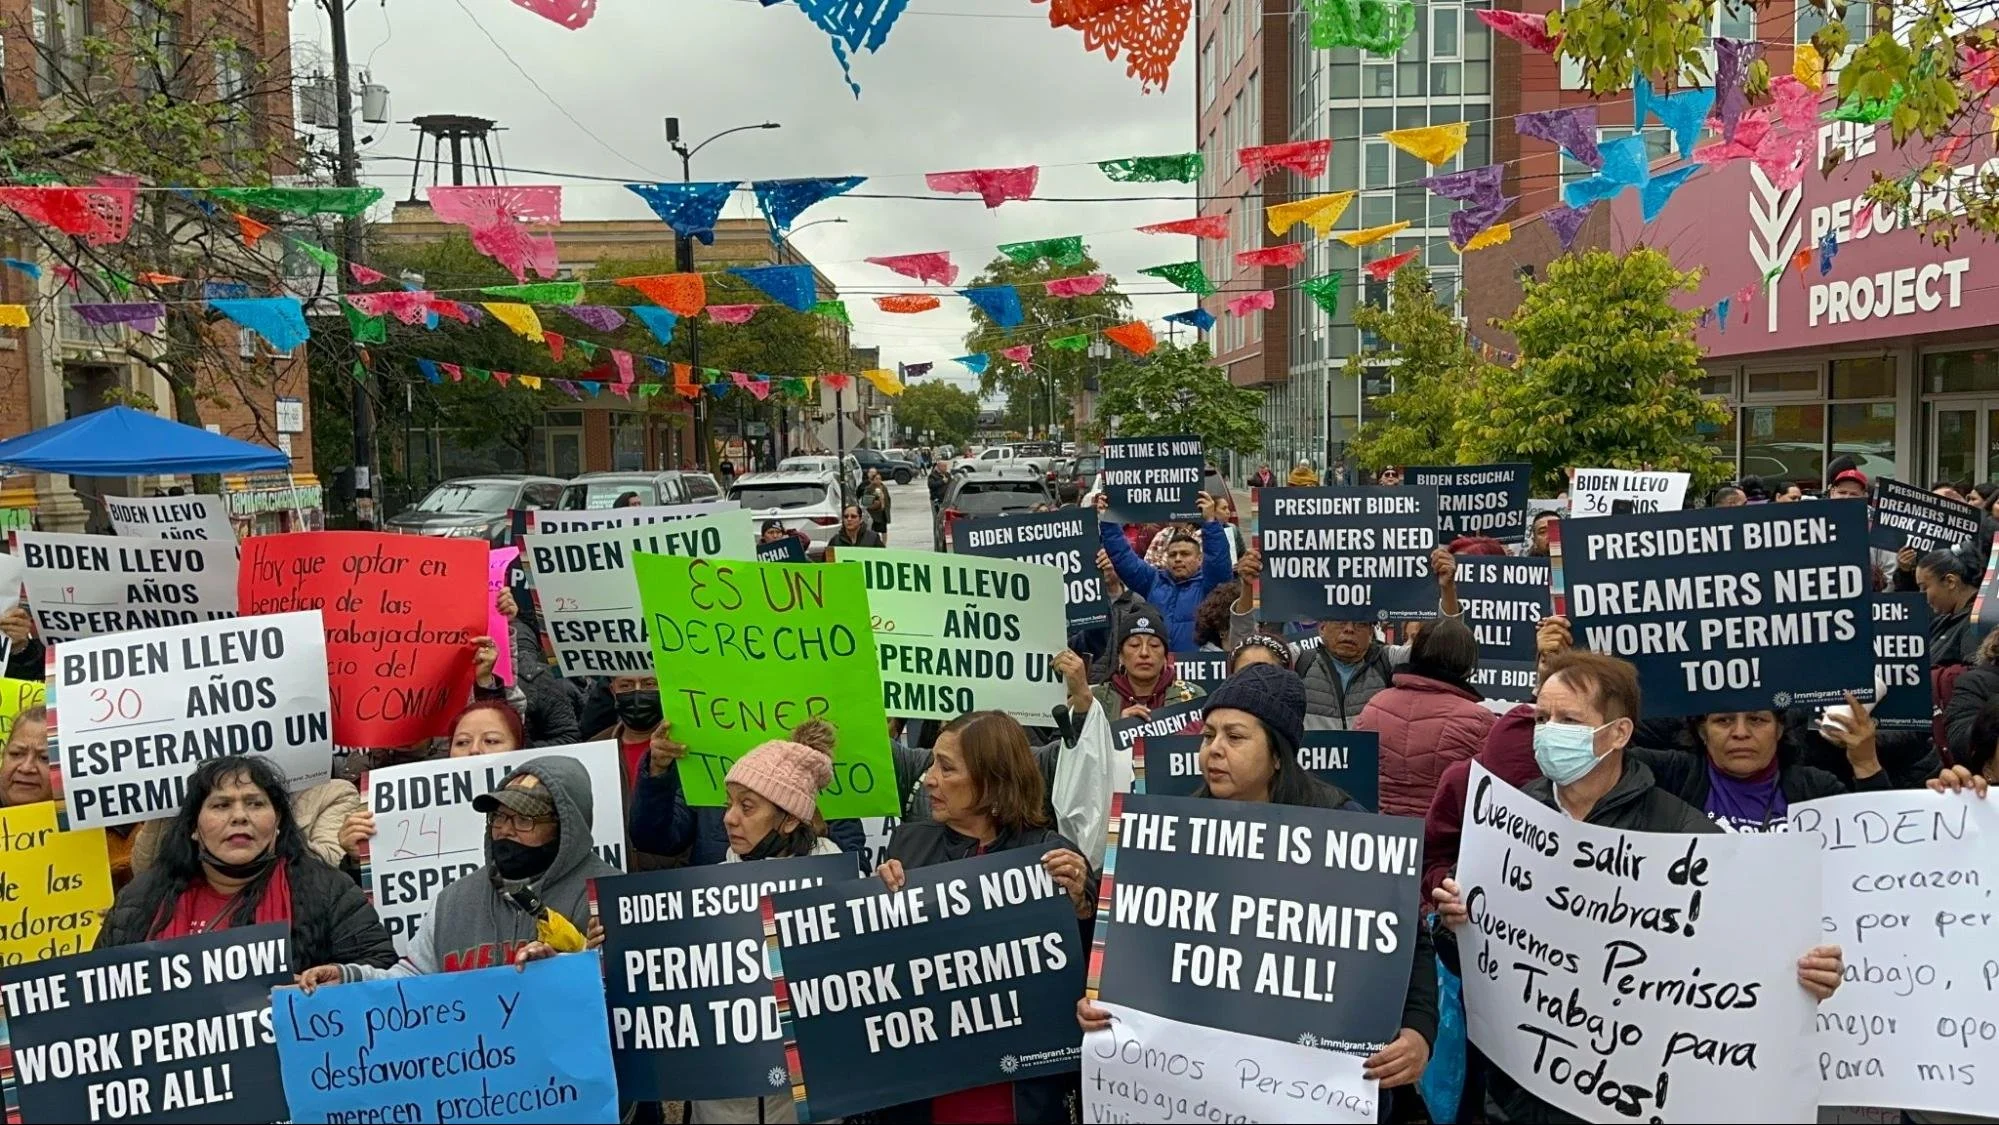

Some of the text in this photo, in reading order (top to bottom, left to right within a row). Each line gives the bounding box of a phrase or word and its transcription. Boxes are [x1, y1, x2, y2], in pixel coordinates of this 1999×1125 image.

[1818, 121, 1876, 170] THE
[1809, 257, 1970, 327] PROJECT
[1104, 441, 1202, 459] THE TIME IS NOW!
[1105, 468, 1199, 486] WORK PERMITS
[1416, 470, 1515, 486] BIDEN ESCUCHA!
[1576, 475, 1669, 492] BIDEN LLEVO
[109, 502, 207, 523] BIDEN LLEVO
[1127, 487, 1181, 503] FOR ALL!
[1274, 497, 1421, 516] PRESIDENT BIDEN:
[1439, 491, 1509, 511] RMISOS
[1584, 493, 1659, 514] 36 ÑOS
[1888, 484, 1972, 515] PRESIDENT BIDEN:
[1460, 510, 1524, 531] TODOS!
[1879, 497, 1978, 533] DREAMERS NEED
[1880, 512, 1917, 531] WORK
[969, 520, 1083, 547] BIDEN ESCUCHA!
[1263, 527, 1434, 551] DREAMERS NEED
[1587, 517, 1838, 561] PRESIDENT BIDEN:
[1905, 534, 1936, 552] TOO!
[23, 542, 205, 573] BIDEN LLEVO
[292, 555, 326, 592] que
[342, 543, 409, 586] optar
[419, 559, 448, 577] en
[533, 540, 624, 574] BIDEN
[1269, 556, 1429, 578] WORK PERMITS
[126, 578, 200, 604] AÑOS
[688, 558, 824, 613] ES UN
[855, 560, 1030, 601] IDEN LLEVO
[1480, 564, 1549, 586] IS NOW!
[1573, 564, 1864, 618] DREAMERS NEED
[251, 588, 412, 614] beneficio de las
[1324, 584, 1372, 606] TOO!
[1462, 599, 1541, 622] PERMITS
[37, 610, 198, 634] ESPERANDO
[325, 620, 470, 652] rabajadoras
[655, 612, 856, 662] DERECHO
[871, 615, 896, 632] 20
[943, 603, 1021, 642] AÑOS
[1473, 625, 1512, 646] ALL!
[1585, 608, 1856, 655] WORK PERMITS
[63, 626, 285, 687] BIDEN LLEVO
[375, 648, 416, 678] del
[880, 643, 1014, 680] PERANDO
[1175, 661, 1206, 681] THE
[1680, 658, 1761, 692] TOO!
[89, 687, 142, 723] 30
[186, 674, 277, 719] AÑOS
[884, 680, 974, 715] RMISO
[1793, 690, 1841, 700] Immigrant
[68, 711, 328, 779] ESPERANDO UN
[374, 770, 474, 814] BIDEN
[394, 813, 442, 858] 24
[1120, 812, 1418, 876] THE TIME IS NOW!
[1472, 775, 1709, 887] Queremos salir de
[1793, 804, 1968, 850] BIDEN
[47, 864, 83, 896] las
[1501, 847, 1702, 938] las sombras!
[618, 890, 683, 925] BIDEN
[774, 879, 971, 948] THE TIME IS
[1115, 883, 1399, 954] WORK PERMITS
[1856, 914, 1912, 943] por
[38, 934, 82, 960] del
[1465, 885, 1762, 1010] Queremos Permisos
[1, 938, 288, 1017] THE TIME IS NOW!
[789, 932, 1068, 1019] WORK PERMITS
[1171, 942, 1337, 1003] FOR ALL!
[287, 994, 344, 1042] Los
[366, 980, 466, 1049] pobres
[612, 995, 783, 1050] PARA TOD
[864, 990, 1023, 1054] FOR ALL!
[1477, 939, 1758, 1071] de Trabajo para
[14, 1006, 276, 1086] WORK PERMITS
[1320, 1037, 1365, 1051] Immigrant
[1816, 1012, 1897, 1045] mejor
[311, 1034, 516, 1092] desfavorecidos
[1020, 1049, 1065, 1062] Immigrant
[1235, 1058, 1372, 1117] Personas
[1517, 1022, 1670, 1125] Todos!
[88, 1063, 234, 1122] FOR ALL!
[326, 1075, 578, 1124] merecen protección
